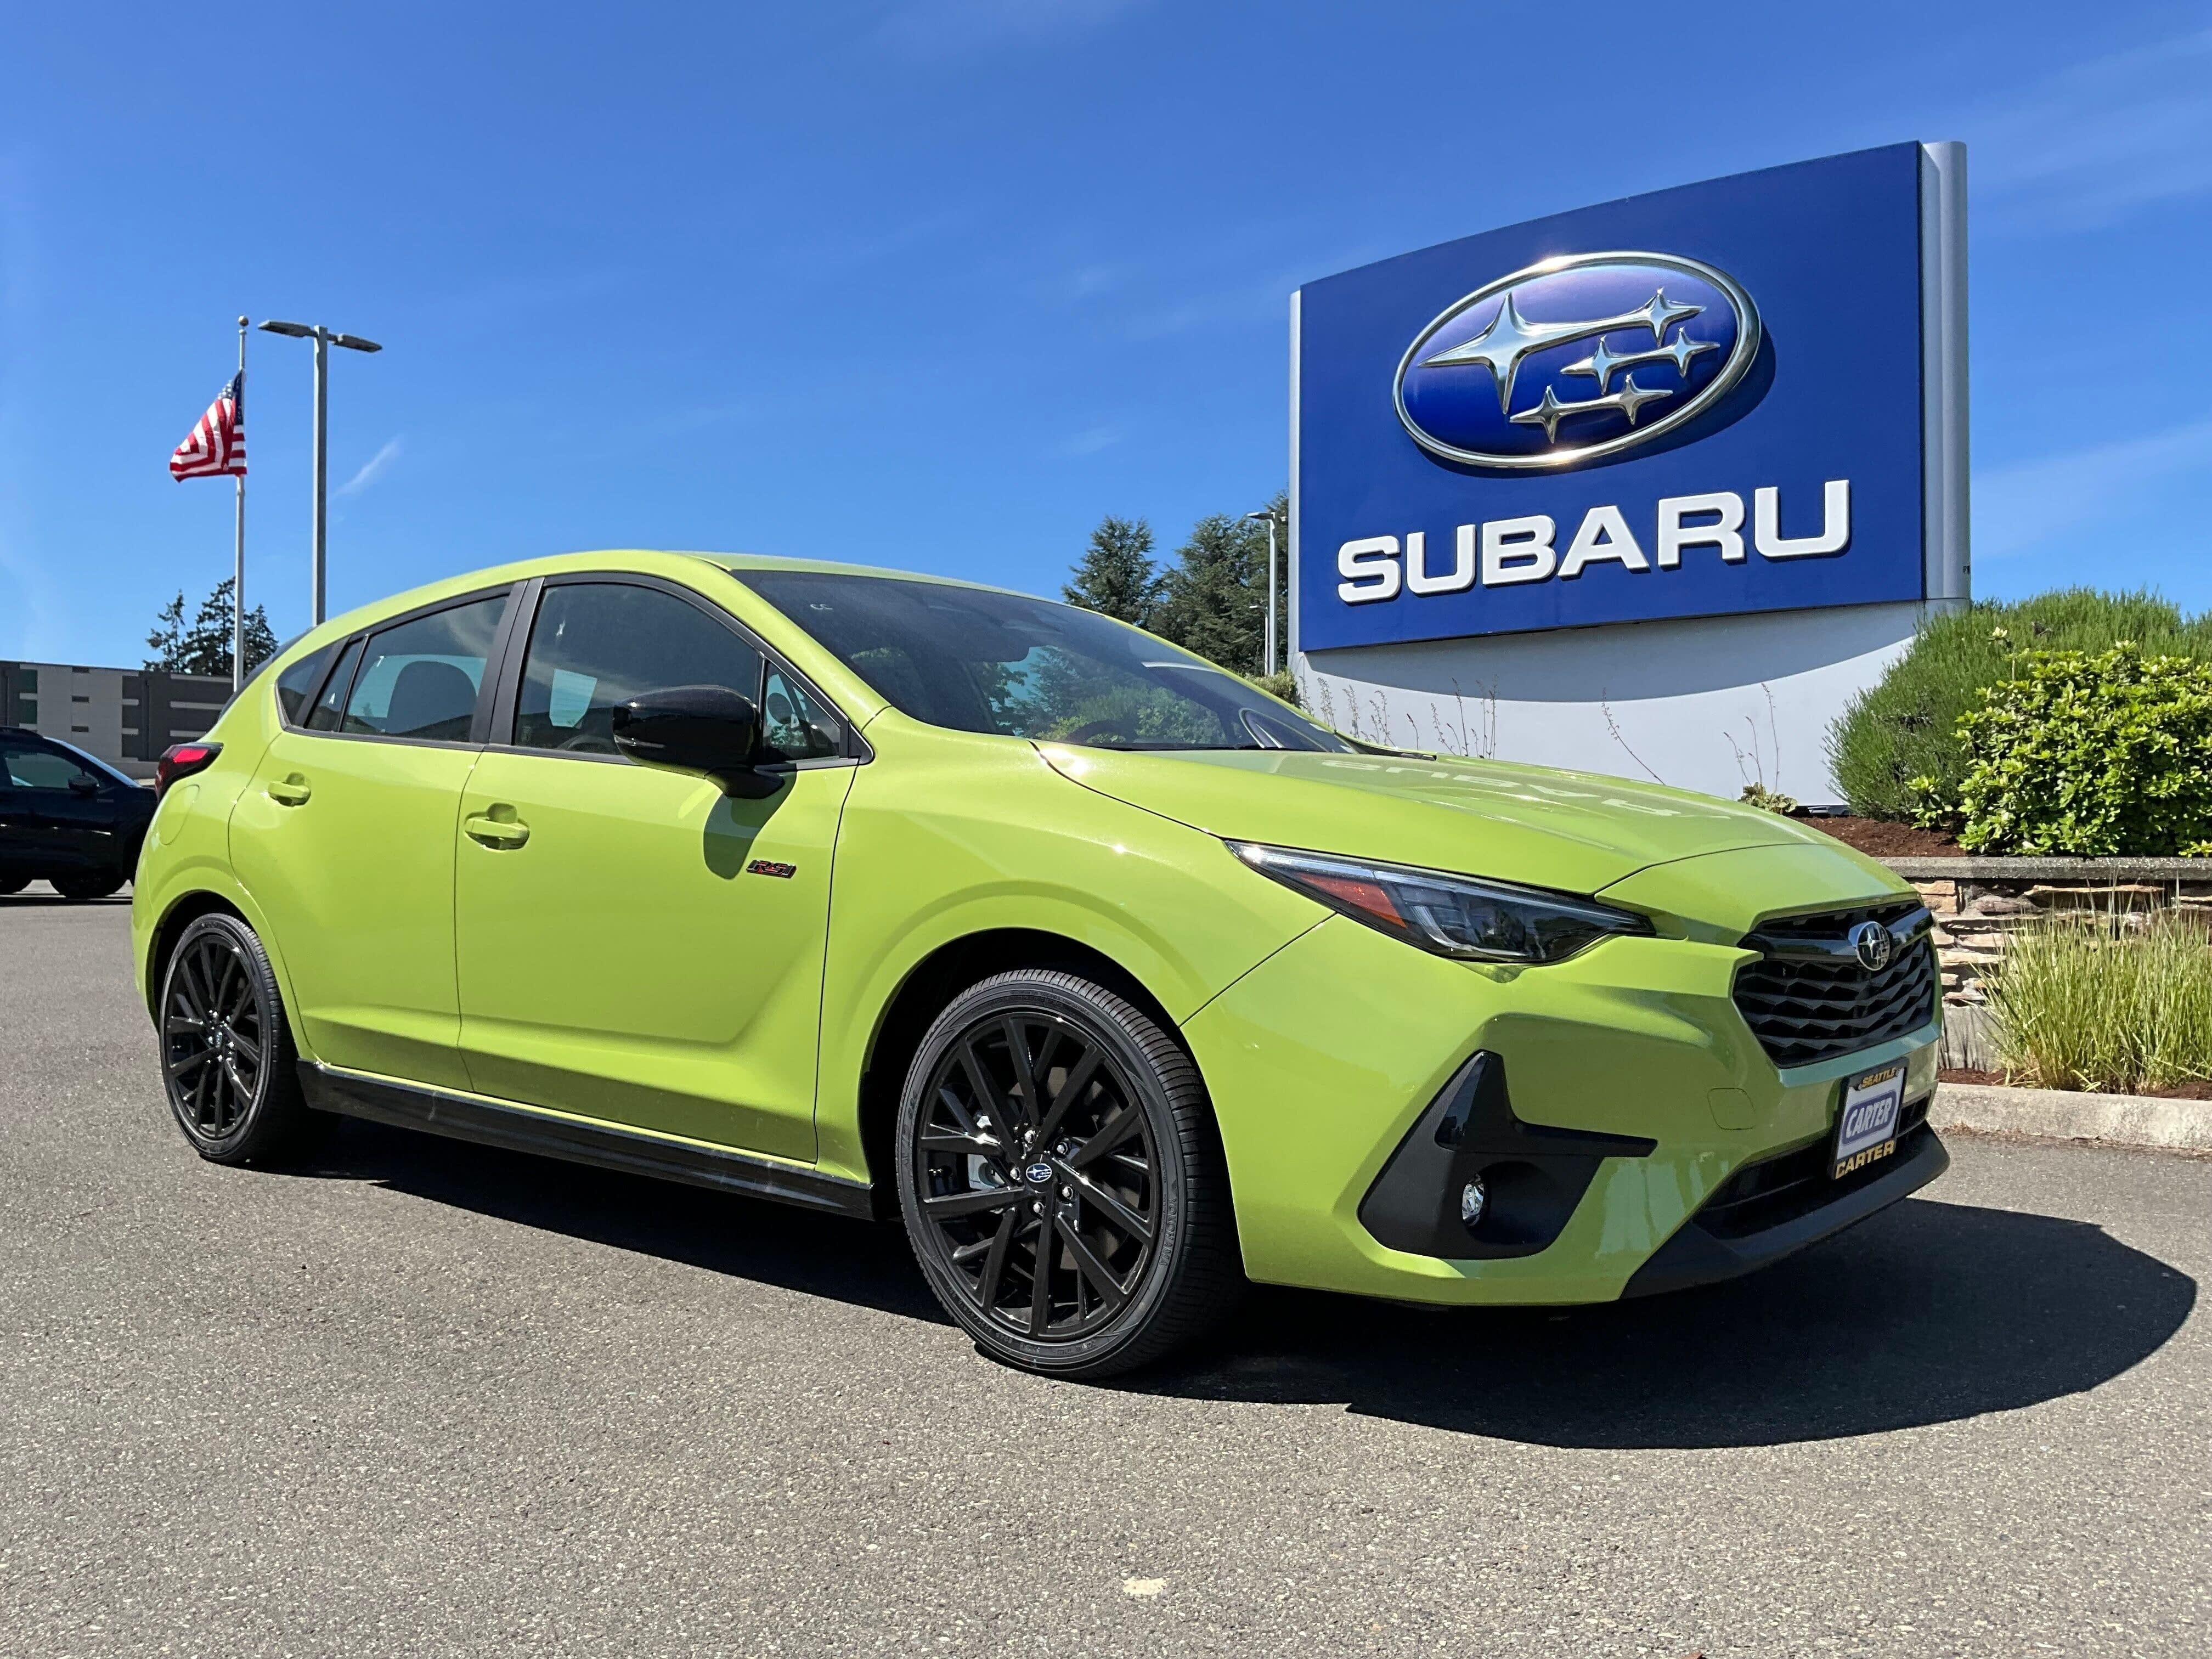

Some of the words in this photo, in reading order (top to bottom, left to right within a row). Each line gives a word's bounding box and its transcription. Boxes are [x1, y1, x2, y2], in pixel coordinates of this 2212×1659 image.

[1337, 479, 1849, 603] SUBARU
[1862, 1067, 1897, 1088] SEATTLE
[1846, 1097, 1893, 1138] CARTER
[1835, 1140, 1895, 1180] CARTER
